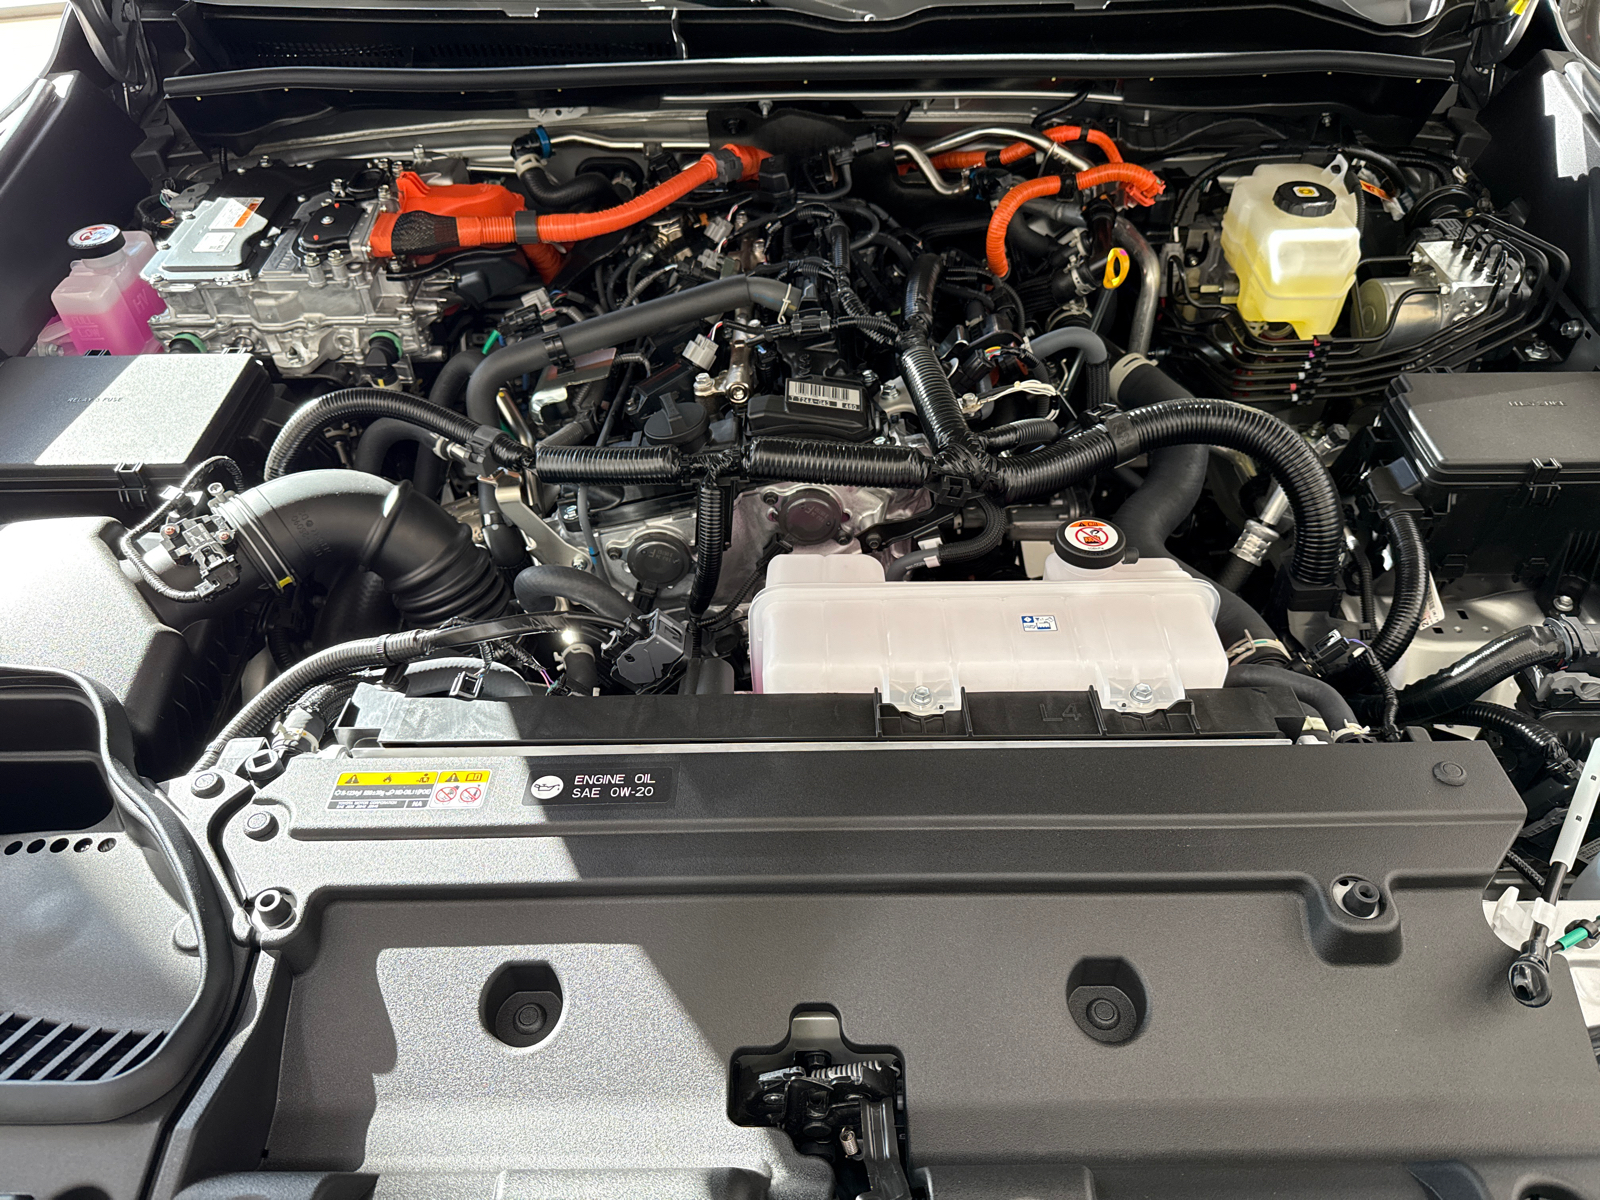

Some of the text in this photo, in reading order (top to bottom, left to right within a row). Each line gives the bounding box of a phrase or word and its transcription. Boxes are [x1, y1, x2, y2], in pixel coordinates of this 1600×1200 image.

[132, 288, 149, 314] HV
[71, 316, 95, 325] FULL
[77, 328, 101, 338] LOW
[1040, 703, 1082, 721] L4
[574, 773, 656, 785] ENGINE OIL
[571, 786, 654, 798] SAE 0W-20
